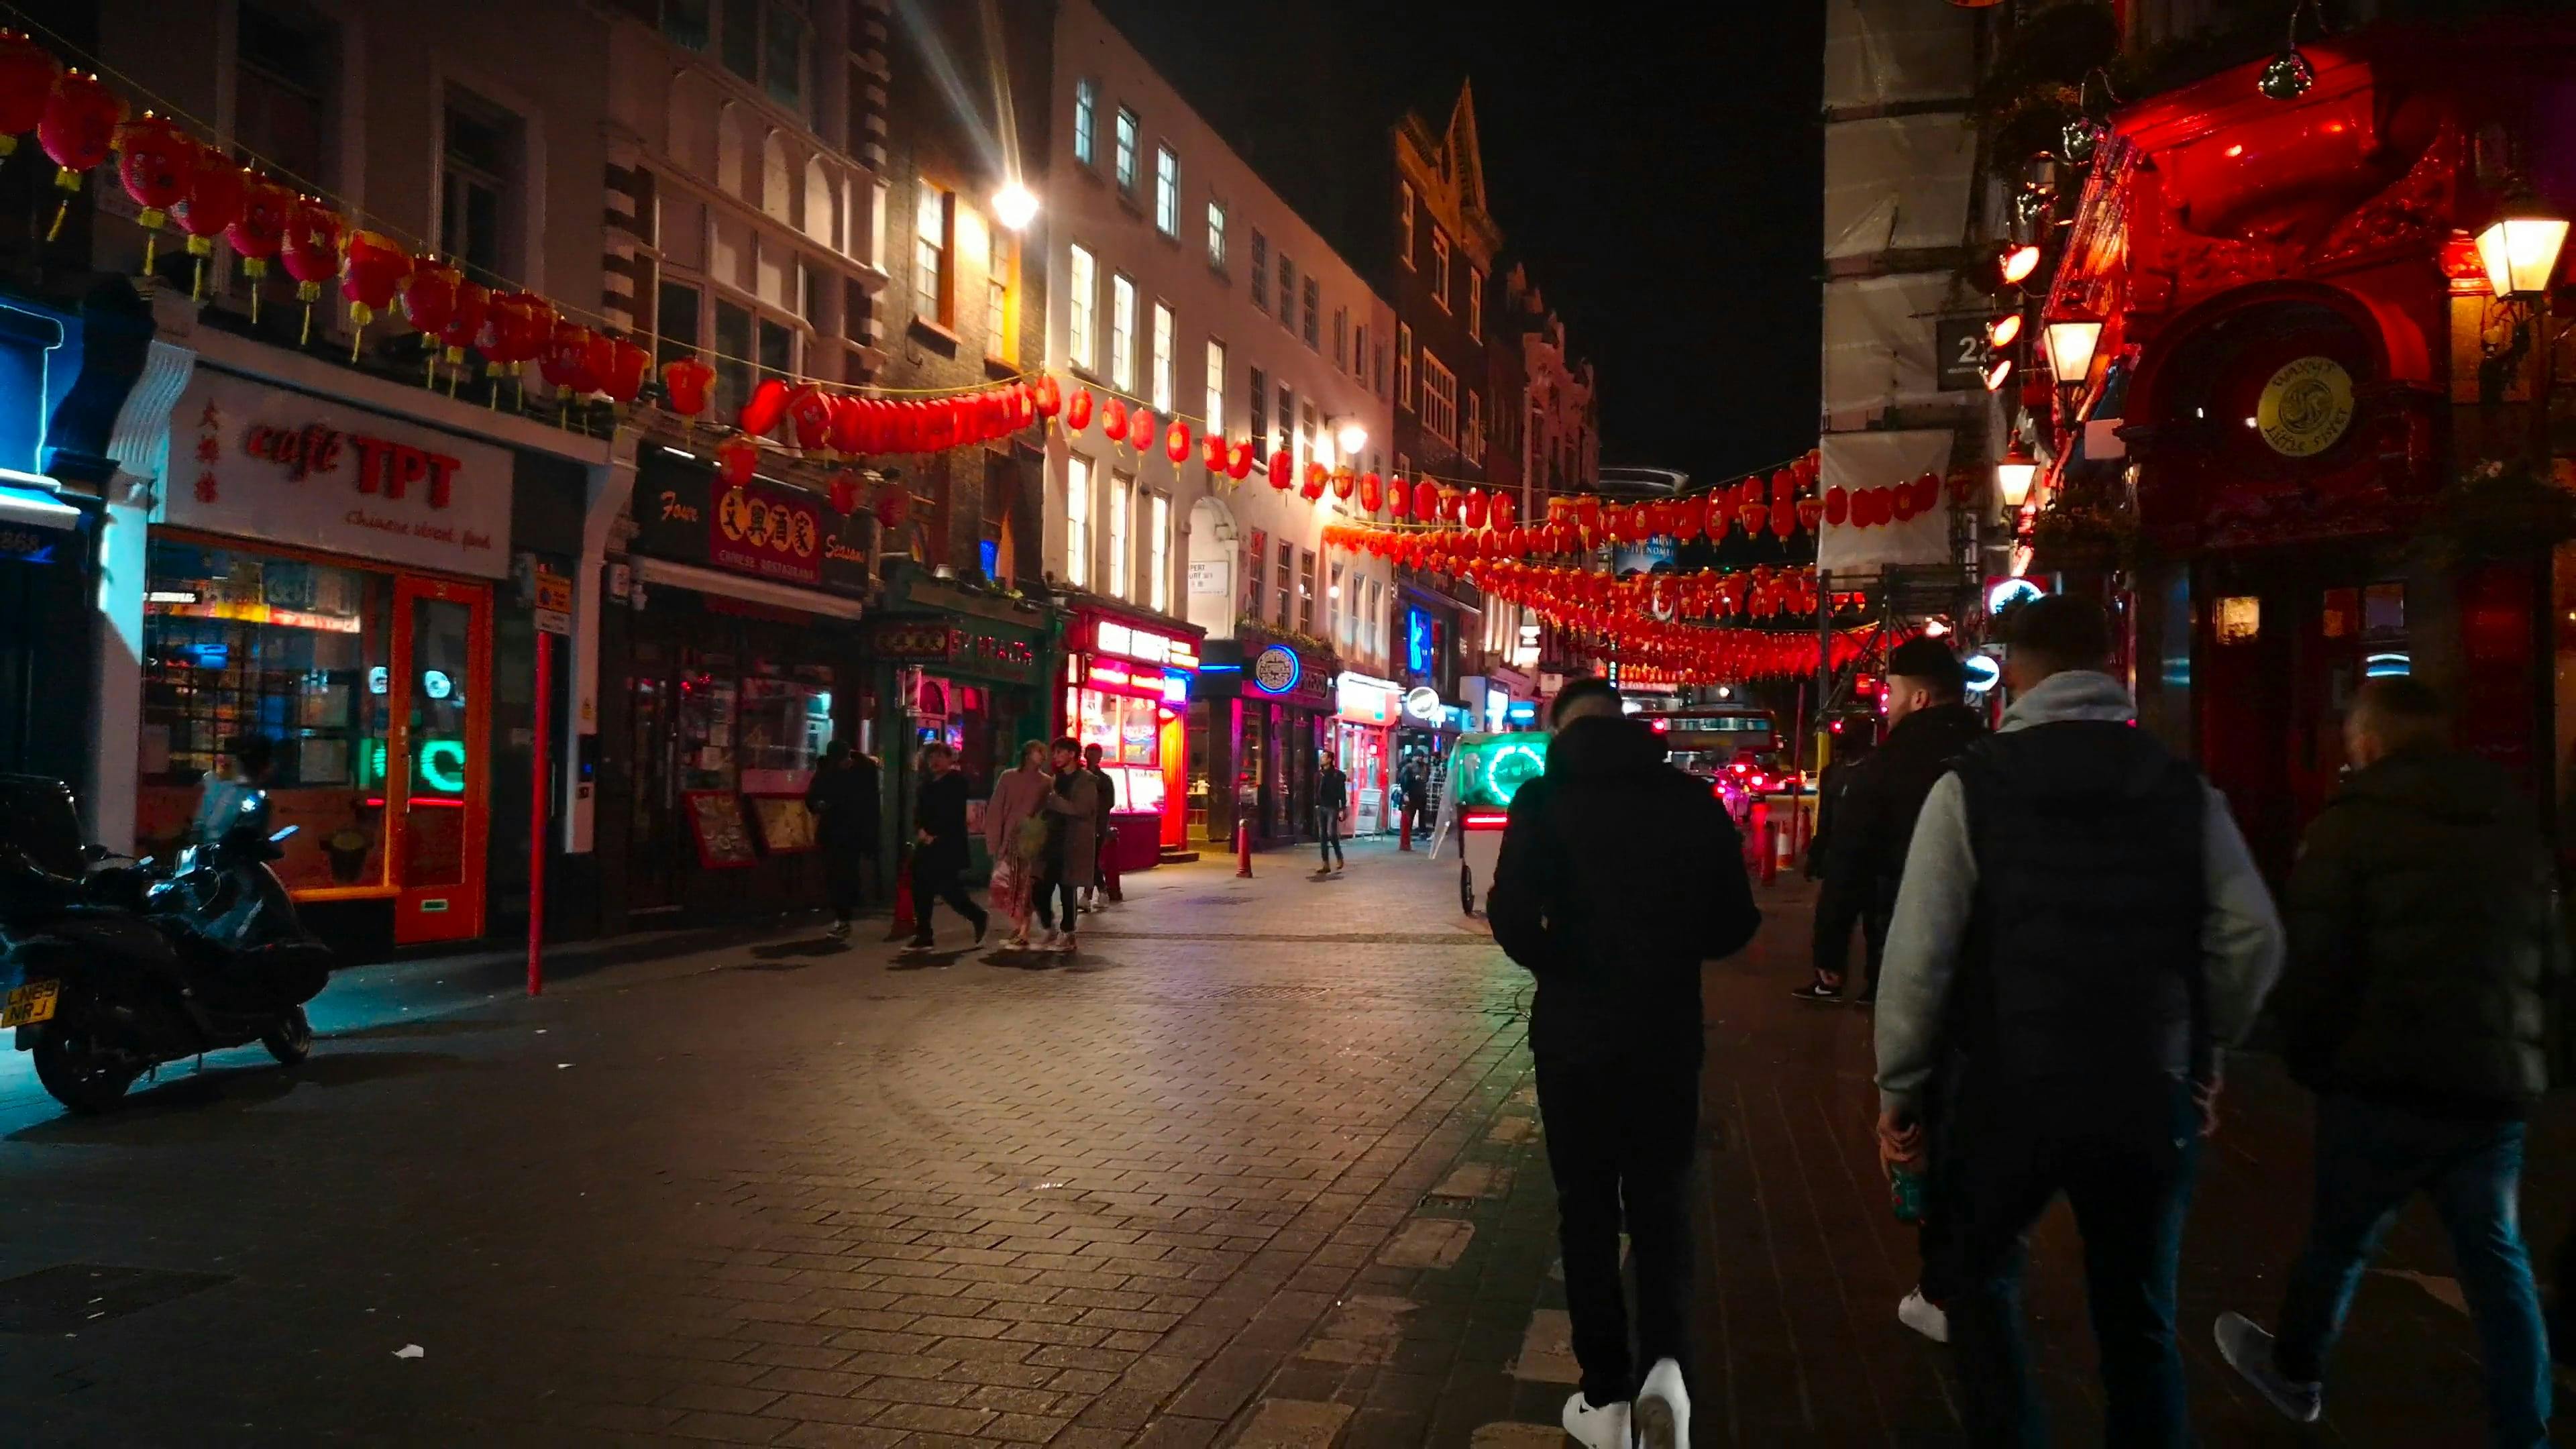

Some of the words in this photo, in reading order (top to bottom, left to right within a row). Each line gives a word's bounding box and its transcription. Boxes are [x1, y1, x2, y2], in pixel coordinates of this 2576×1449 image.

[246, 423, 340, 483] café
[352, 435, 461, 508] TPT
[660, 490, 699, 523] Four
[345, 509, 409, 535] Chinese
[414, 521, 454, 543] street
[462, 527, 491, 551] food
